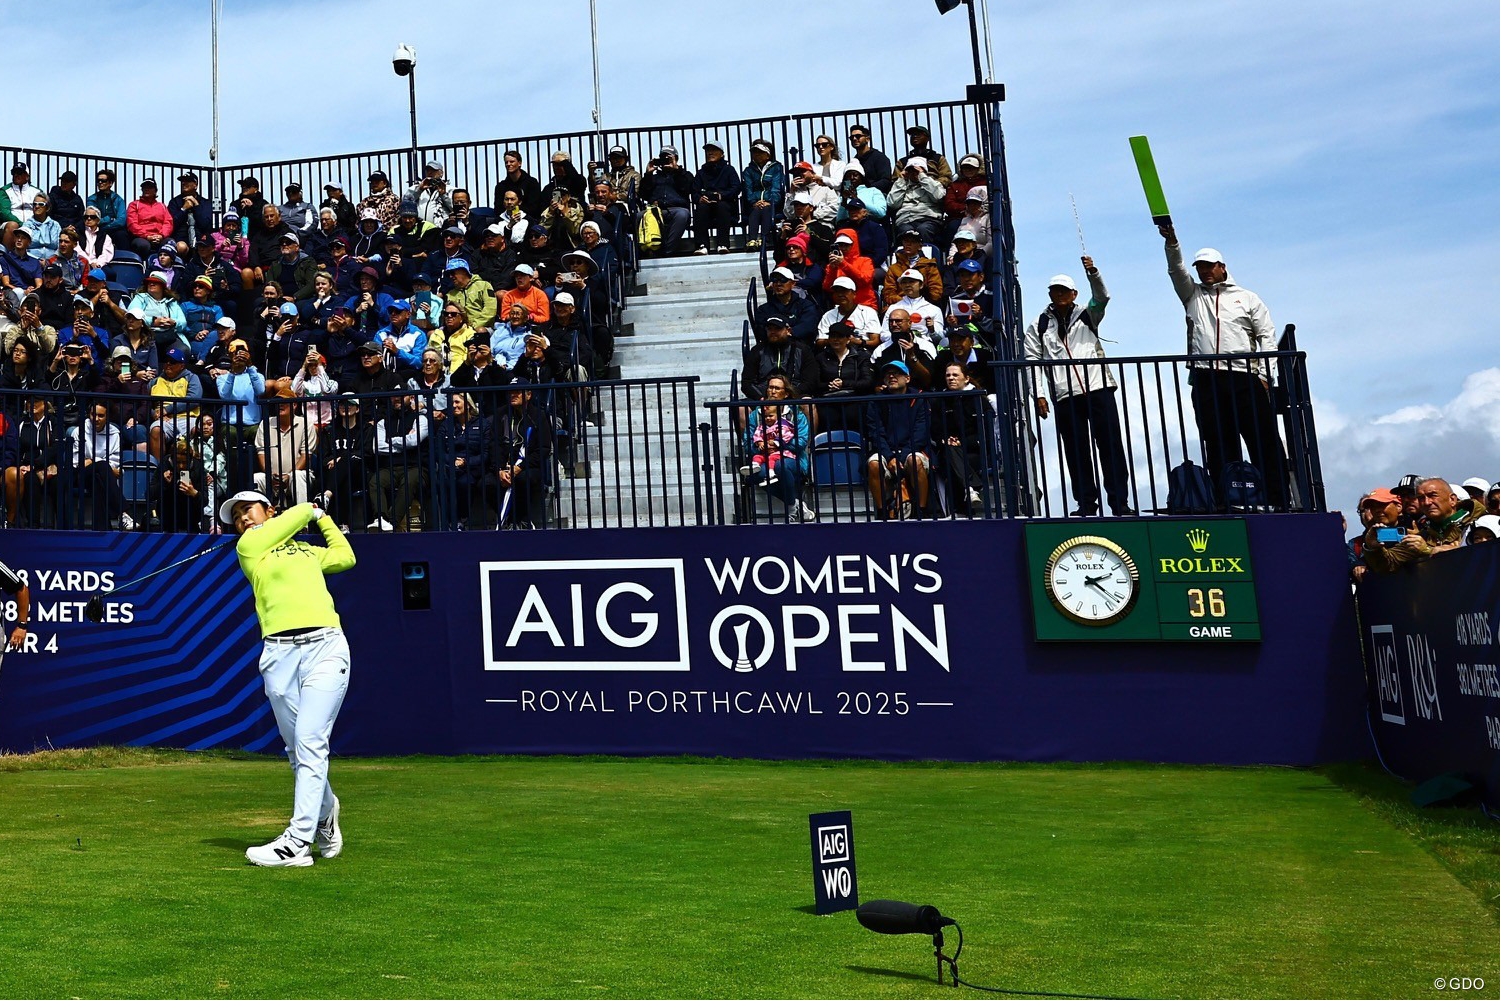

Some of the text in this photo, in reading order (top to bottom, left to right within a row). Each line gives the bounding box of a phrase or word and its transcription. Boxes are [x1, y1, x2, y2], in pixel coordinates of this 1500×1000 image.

[704, 553, 943, 595] WOMEN'S
[1159, 557, 1245, 573] ROLEX
[35, 570, 115, 592] YARDS
[38, 601, 134, 623] METES
[505, 582, 659, 648] AIG
[1187, 588, 1226, 617] 36
[709, 603, 950, 673] OPEN
[1189, 626, 1232, 638] GAME
[1465, 611, 1492, 646] YARDS
[44, 633, 58, 654] 4
[1378, 645, 1398, 703] AIG
[521, 690, 910, 715] ROYAL PORTHCAWL 2025
[823, 832, 845, 856] AIG
